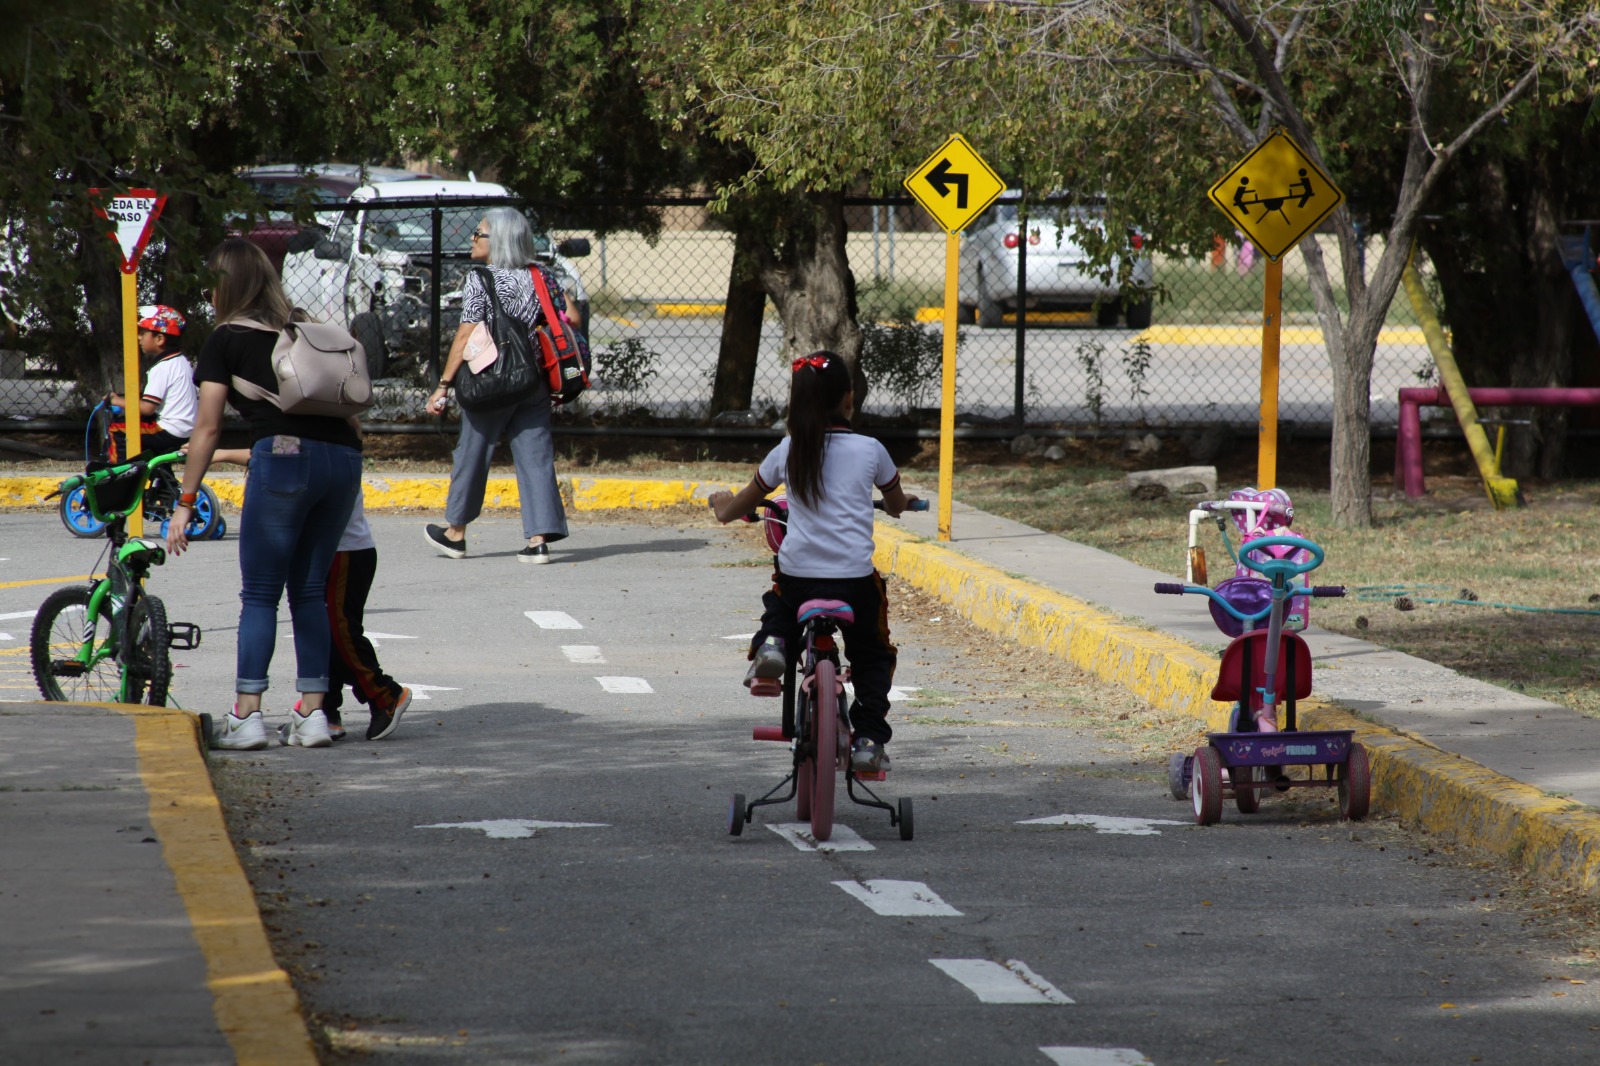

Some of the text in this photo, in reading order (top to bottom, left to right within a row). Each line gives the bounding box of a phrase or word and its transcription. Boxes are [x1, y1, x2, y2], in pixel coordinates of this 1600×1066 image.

[137, 200, 150, 209] EL
[118, 212, 142, 222] ASO
[1285, 744, 1317, 756] FRIENDS
